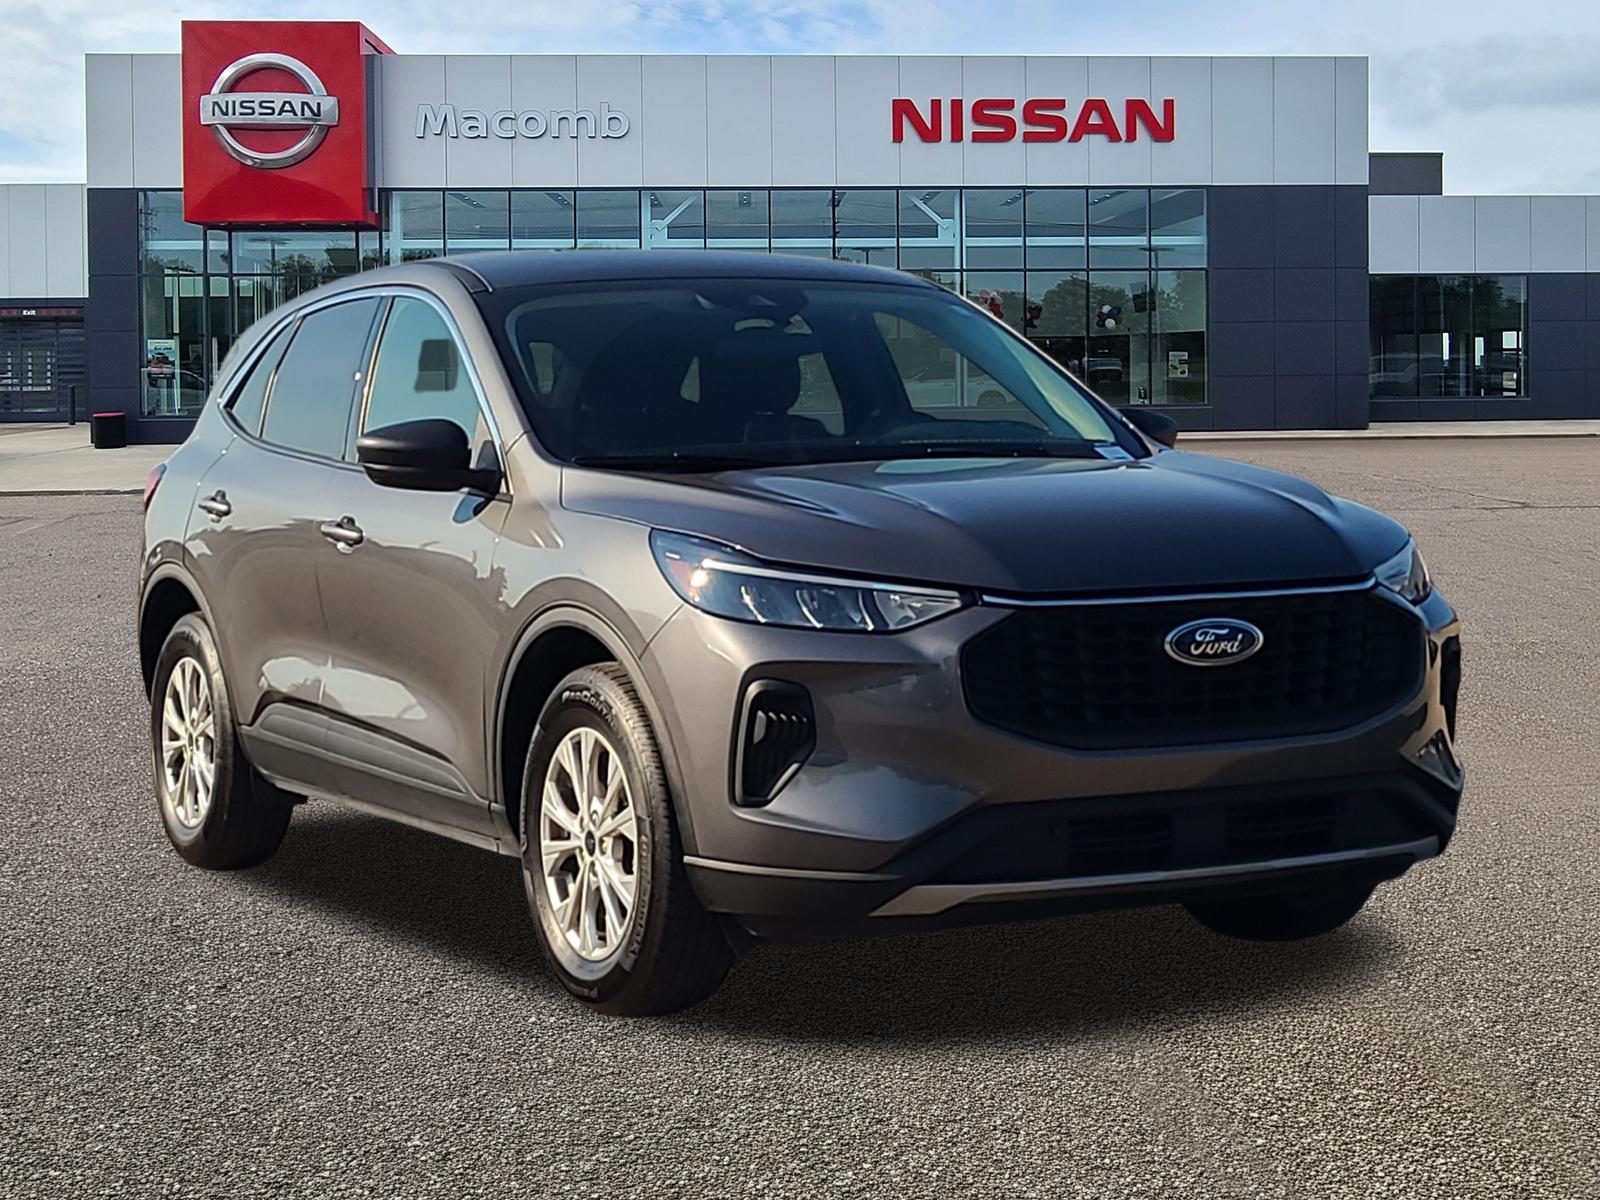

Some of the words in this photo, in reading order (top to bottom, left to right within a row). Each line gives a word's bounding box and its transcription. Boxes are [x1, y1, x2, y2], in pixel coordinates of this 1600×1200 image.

[211, 100, 322, 118] NISSAN
[415, 101, 630, 139] Macomb
[892, 98, 1175, 143] NISSAN
[1190, 627, 1244, 656] Ford
